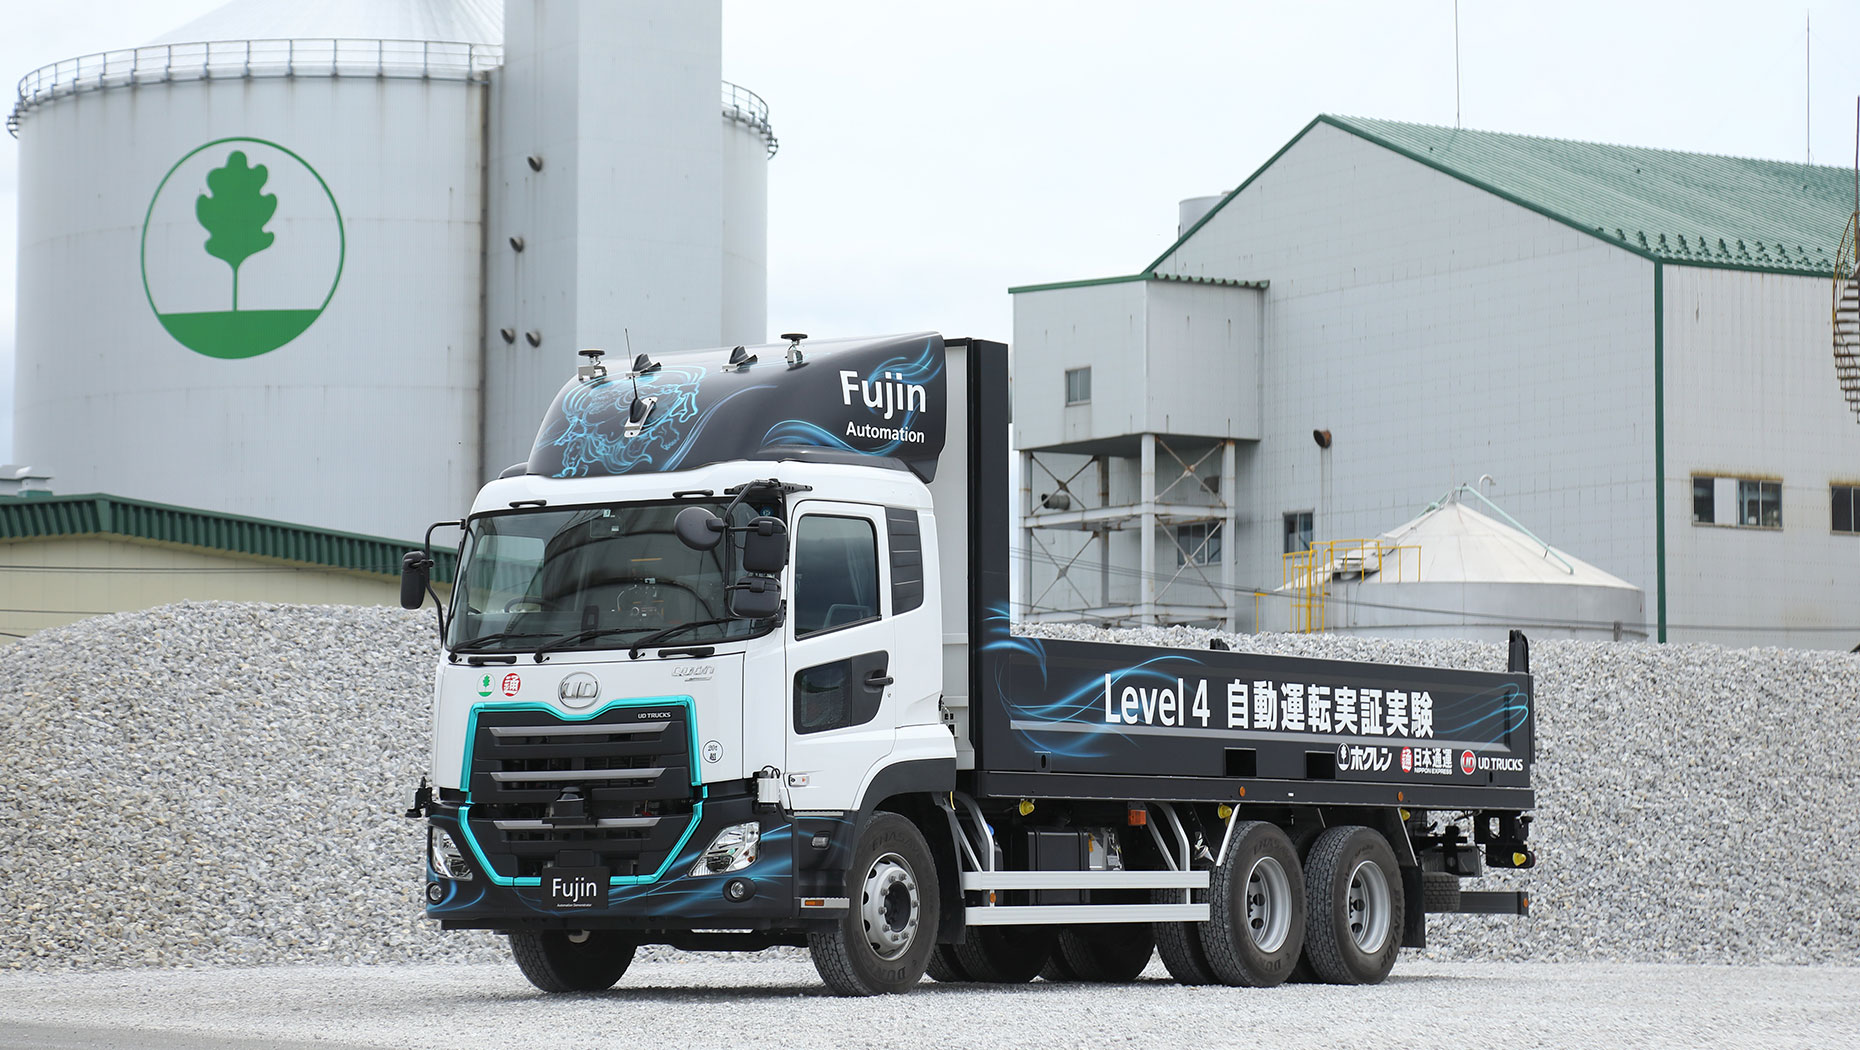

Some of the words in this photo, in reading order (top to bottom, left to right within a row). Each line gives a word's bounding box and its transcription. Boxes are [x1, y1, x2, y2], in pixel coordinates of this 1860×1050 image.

[839, 370, 927, 420] Fujin
[845, 421, 925, 444] Automation
[647, 711, 671, 719] TRUCKS
[1104, 673, 1185, 727] Level
[1191, 679, 1211, 728] 4
[1227, 678, 1434, 739] 自動運転実証実験
[1350, 745, 1393, 772] ホクレン
[1413, 747, 1453, 769] 日本通運
[1478, 756, 1491, 770] UD
[1491, 757, 1524, 772] TRUCKS
[1432, 768, 1453, 776] EXPRESS
[552, 876, 597, 903] Fujin
